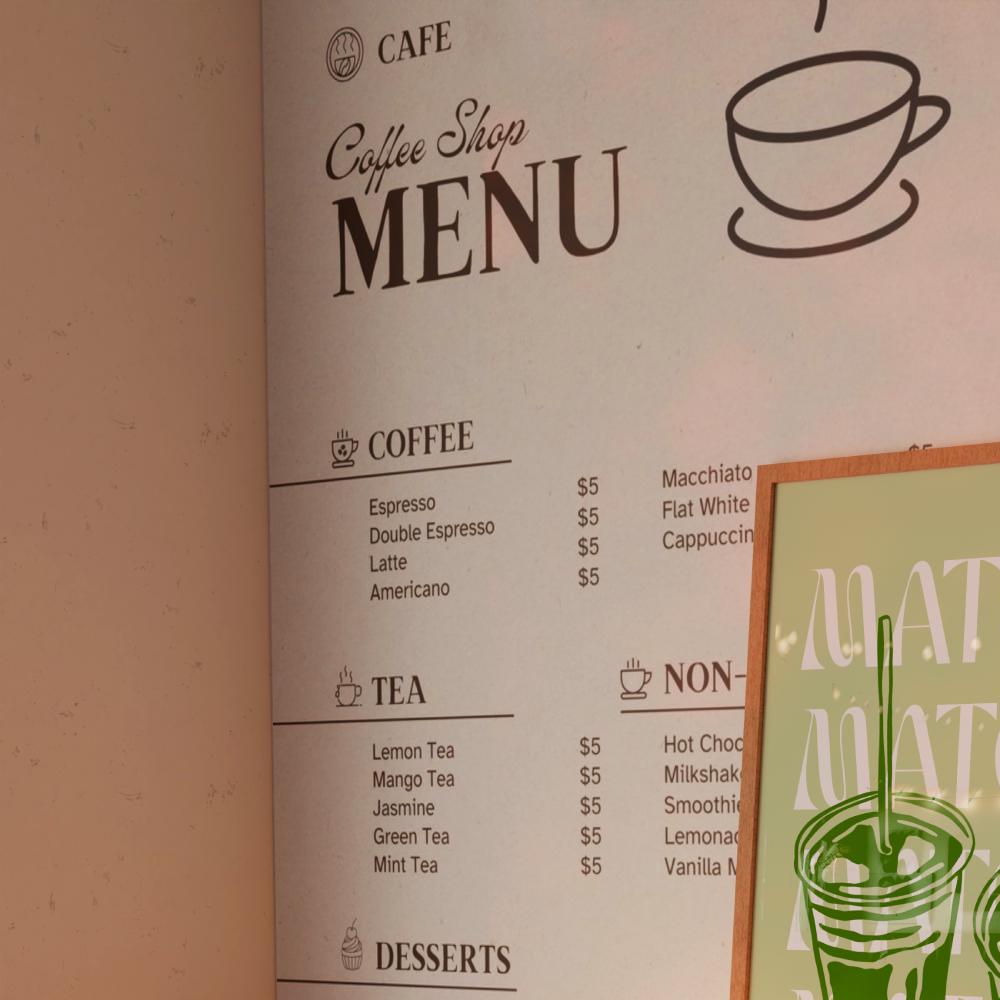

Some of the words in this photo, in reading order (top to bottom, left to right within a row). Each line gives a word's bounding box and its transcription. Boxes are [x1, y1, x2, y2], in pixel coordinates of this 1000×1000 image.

[378, 21, 451, 64] CAFE
[325, 123, 426, 195] Coffee
[437, 98, 528, 170] Shop
[332, 145, 627, 297] MENU
[369, 421, 473, 460] COFFEE
[663, 464, 752, 488] Macchiato
[578, 477, 598, 497] $5
[370, 497, 435, 518] Espresso
[663, 500, 693, 519] Flat
[700, 494, 749, 516] White
[578, 507, 598, 528] $5
[370, 525, 421, 544] Double
[427, 521, 494, 541] Espresso
[578, 537, 599, 557] $5
[370, 555, 407, 572] Latte
[579, 567, 599, 587] $5
[370, 580, 449, 601] Americano
[664, 660, 745, 694] NON-
[372, 676, 426, 705] TEA
[373, 744, 422, 760] Lemon
[427, 742, 454, 759] Tea
[580, 737, 600, 756] $5
[665, 736, 693, 753] Hot
[373, 771, 422, 792] Mango
[427, 770, 454, 787] Tea
[580, 766, 600, 785] $5
[663, 764, 742, 784] Milkshak
[373, 798, 434, 816] Jasmine
[581, 796, 601, 815] $5
[374, 827, 417, 845] Green
[422, 827, 449, 845] Tea
[581, 826, 601, 846] $5
[374, 855, 406, 872] Mint
[410, 856, 437, 873] Tea
[581, 856, 601, 875] $5
[665, 857, 721, 876] Vanilla
[376, 942, 510, 974] DESSERTS
